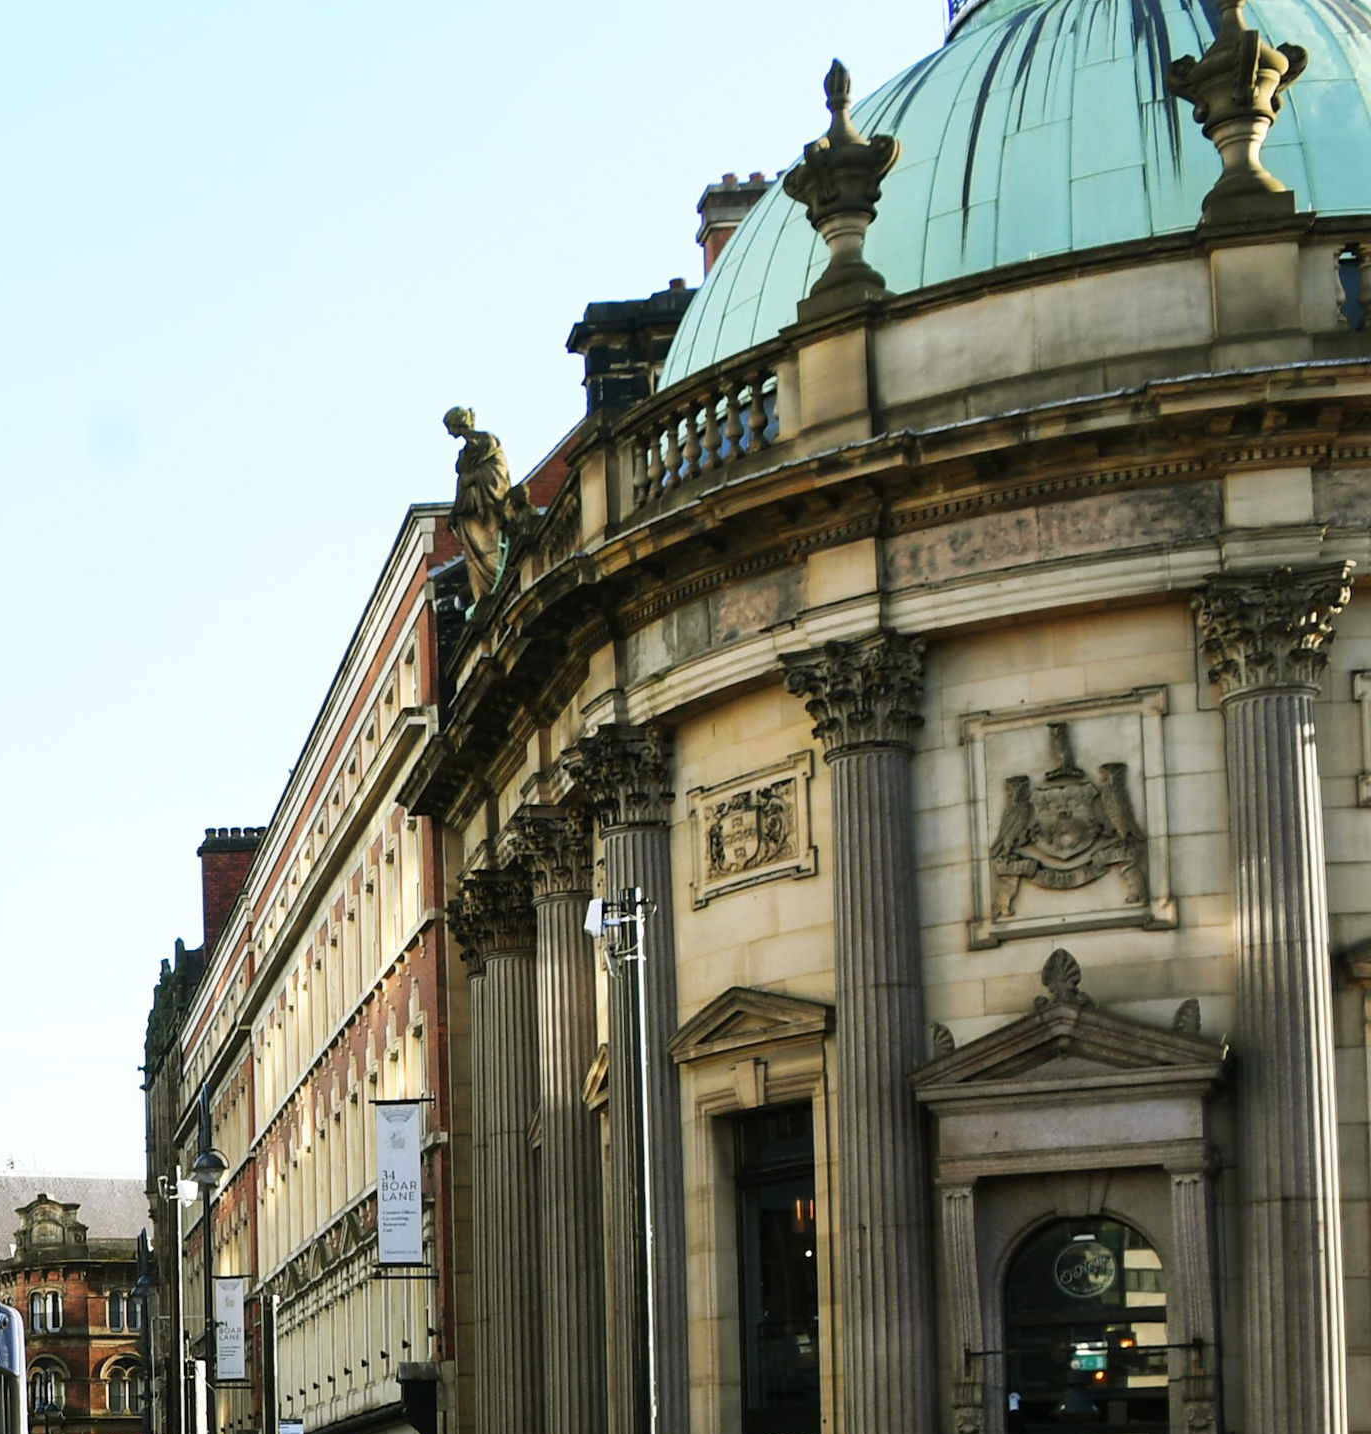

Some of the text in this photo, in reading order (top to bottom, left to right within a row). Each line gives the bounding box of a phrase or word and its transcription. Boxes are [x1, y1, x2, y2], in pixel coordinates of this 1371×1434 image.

[381, 1170, 395, 1181] 34
[382, 1181, 417, 1191] BOAR
[382, 1192, 415, 1201] LANE
[219, 1326, 242, 1334] BOAR
[219, 1334, 240, 1342] LANE
